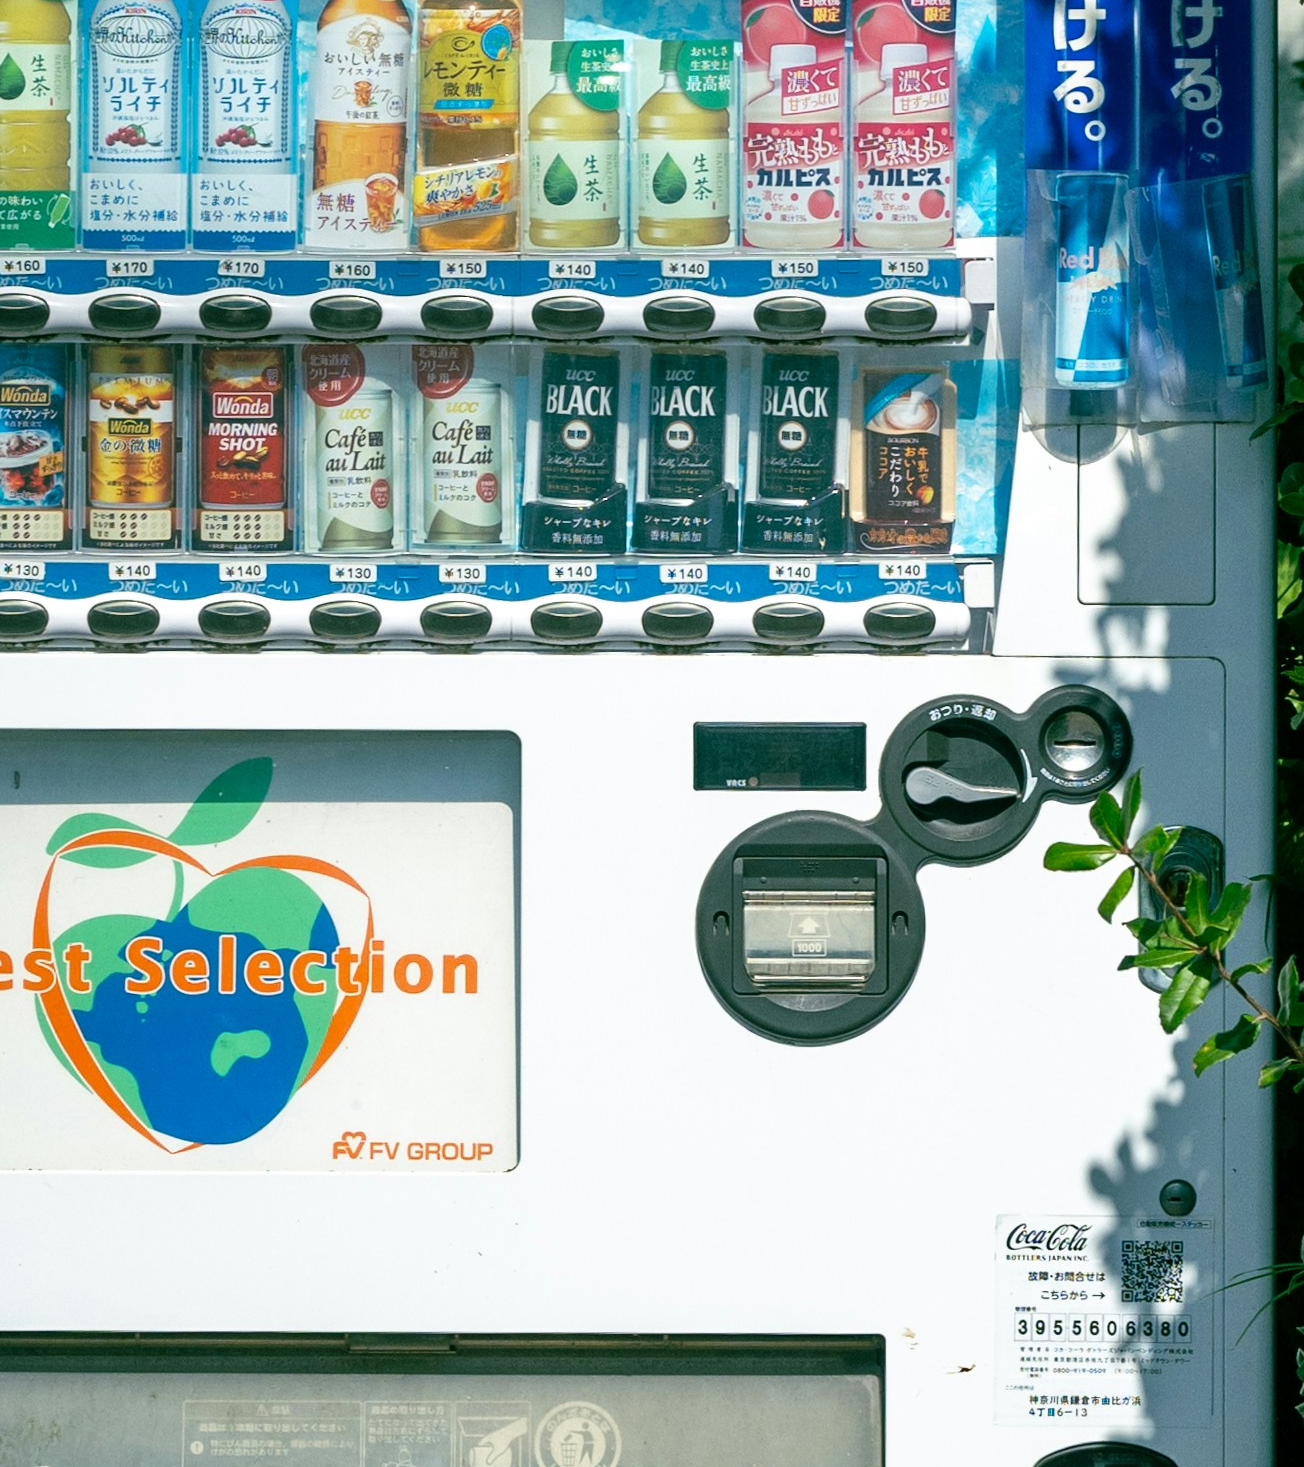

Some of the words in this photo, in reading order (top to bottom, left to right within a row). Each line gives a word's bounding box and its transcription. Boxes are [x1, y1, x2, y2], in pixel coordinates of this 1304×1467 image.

[813, 6, 841, 23] 限定
[924, 6, 952, 23] 限定
[324, 51, 405, 67] おいしい無糖
[690, 45, 729, 57] おいしさ
[423, 60, 506, 81] レモンティー
[689, 59, 730, 72] 生茶史上
[30, 53, 52, 98] 生茶
[685, 74, 731, 93] 最高級
[787, 66, 838, 94] 濃くて
[898, 66, 949, 94] 濃くて
[102, 76, 170, 94] ソルティ
[212, 76, 280, 94] ソルティ
[442, 81, 484, 97] 微糖
[110, 95, 162, 113] ライチ
[219, 95, 272, 113] ライチ
[583, 153, 604, 202] 生茶
[692, 152, 713, 202] 生茶
[756, 167, 832, 188] カルピス
[867, 167, 943, 188] カルピス
[89, 194, 140, 206] こまめに
[199, 194, 250, 206] こまめに
[426, 184, 475, 204] 爽やかさ
[316, 193, 356, 213] 無糖
[89, 208, 179, 223] 塩分・水分補給
[199, 209, 289, 223] 塩分・水分補給
[1059, 246, 1095, 269] Red
[111, 261, 148, 274] ¥170
[334, 263, 371, 277] ¥160
[555, 264, 592, 275] ¥140
[778, 261, 815, 275] ¥150
[310, 367, 352, 380] クリーム
[418, 359, 461, 372] クリーム
[318, 380, 342, 392] 使用
[0, 386, 48, 404] Wonda
[545, 385, 613, 416] BLACK
[650, 385, 717, 417] BLACK
[761, 385, 830, 418] BLACK
[216, 396, 270, 415] Wonda
[110, 419, 150, 435] Wonda
[208, 422, 279, 436] MORNING
[432, 419, 473, 443] Café
[98, 437, 162, 453] 金の微糖
[219, 437, 266, 452] SHOT
[324, 425, 367, 450] Café
[878, 447, 889, 480] ココア
[904, 447, 916, 496] おいしく
[917, 447, 930, 484] 牛乳で
[889, 447, 903, 498] こだわり
[544, 516, 612, 528] シャープなキレ
[644, 513, 713, 527] シャープなキレ
[756, 514, 823, 528] シャープなキレ
[552, 533, 604, 545] 香料無添加
[649, 531, 703, 543] 香料無添加
[762, 531, 814, 544] 香料無添加
[114, 564, 151, 577] ¥140
[335, 567, 372, 580] ¥130
[555, 566, 593, 579] ¥140
[775, 565, 812, 579] ¥140
[928, 704, 998, 721] おつり・返却
[797, 942, 822, 953] 1000
[125, 935, 480, 995] Selection
[369, 1142, 401, 1161] FV
[406, 1142, 495, 1161] GROUP
[1006, 1223, 1093, 1251] Coca-Cola
[1028, 1271, 1106, 1282] 故障・お問合せは
[1040, 1289, 1089, 1301] こちらから
